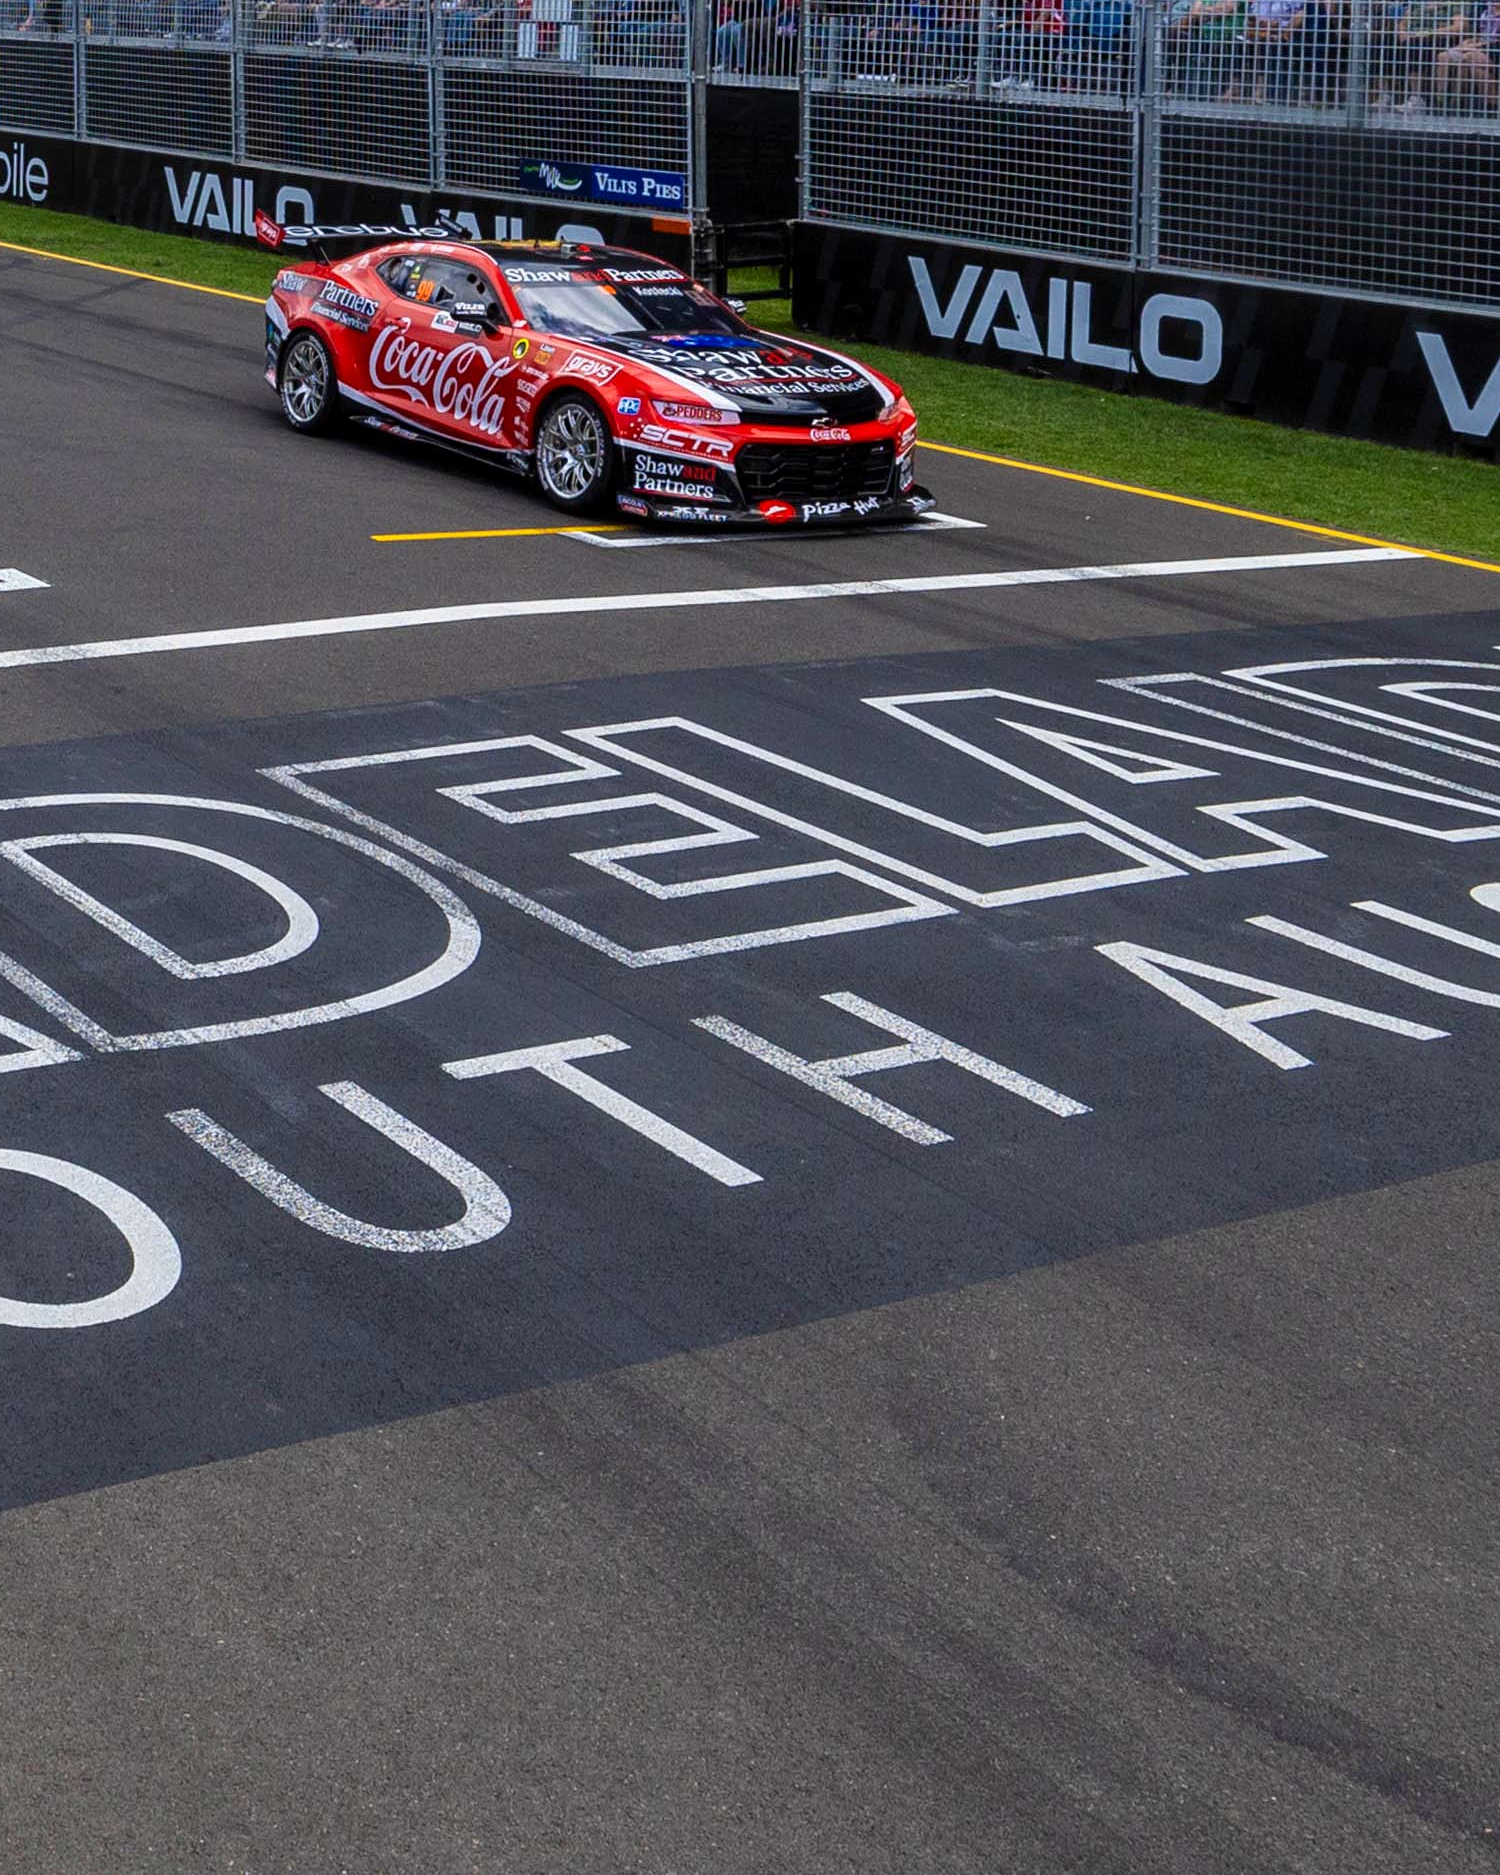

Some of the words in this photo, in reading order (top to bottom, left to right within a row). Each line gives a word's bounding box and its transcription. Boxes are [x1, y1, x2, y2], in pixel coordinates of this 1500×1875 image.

[594, 172, 638, 194] VILI'S
[641, 177, 681, 200] PIES
[163, 166, 314, 247] VAILO
[284, 224, 449, 238] erebus
[507, 268, 571, 283] Shaw
[606, 268, 684, 282] Partners
[320, 281, 379, 317] Partners
[415, 280, 435, 301] 99
[908, 256, 1223, 385] VAILO
[565, 354, 613, 379] grays
[627, 347, 762, 365] Shaw
[369, 317, 520, 435] Coca-Cola
[663, 363, 853, 382] Partners
[808, 378, 870, 393] Services
[676, 405, 722, 422] PEDDERS
[640, 424, 734, 457] SCTR
[634, 454, 684, 476] Shaw
[684, 467, 717, 483] and
[633, 471, 714, 499] Partners
[854, 496, 880, 515] Hut
